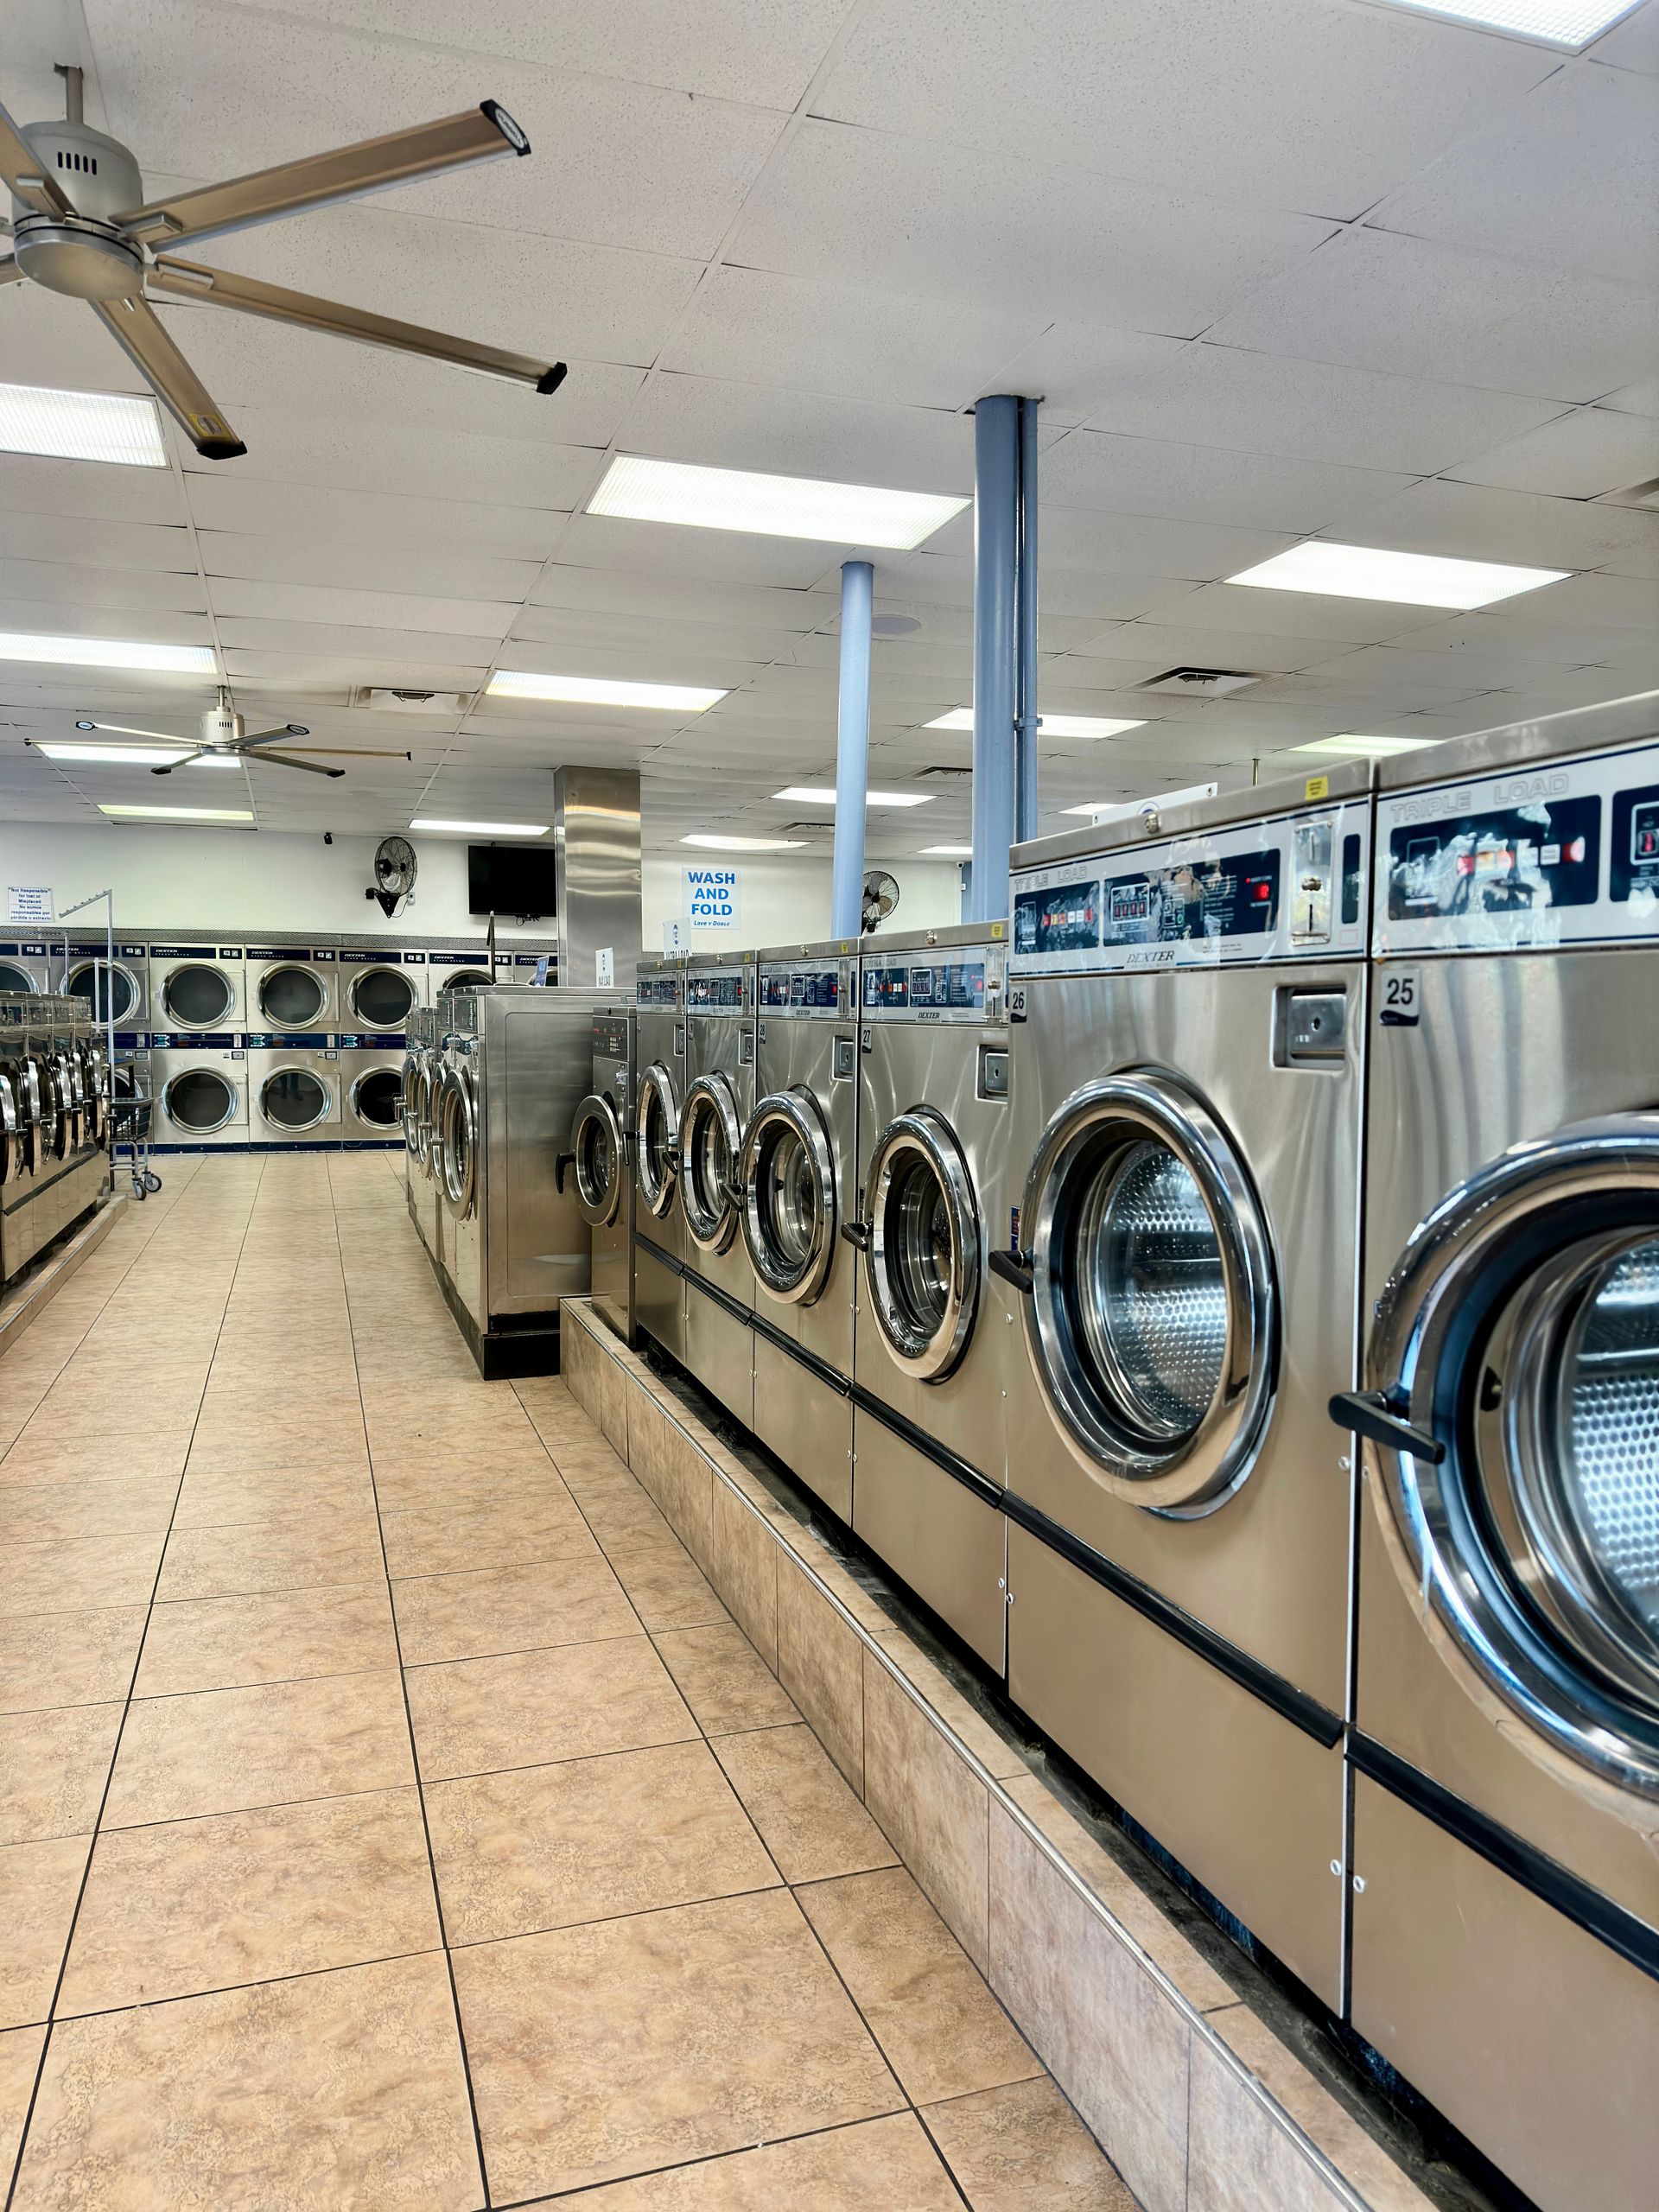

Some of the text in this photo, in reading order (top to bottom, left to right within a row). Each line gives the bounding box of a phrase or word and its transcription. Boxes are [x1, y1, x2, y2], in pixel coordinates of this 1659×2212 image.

[1390, 773, 1569, 823] TRIPLE LOAD
[688, 872, 735, 884] WASH
[1014, 866, 1088, 891] TRIPLE LOAD
[695, 888, 729, 899] AND
[691, 904, 733, 915] FOLD
[1127, 950, 1175, 963] DEXTER
[1387, 978, 1414, 1005] 25
[1013, 992, 1025, 1009] 26
[863, 1030, 871, 1043] 27
